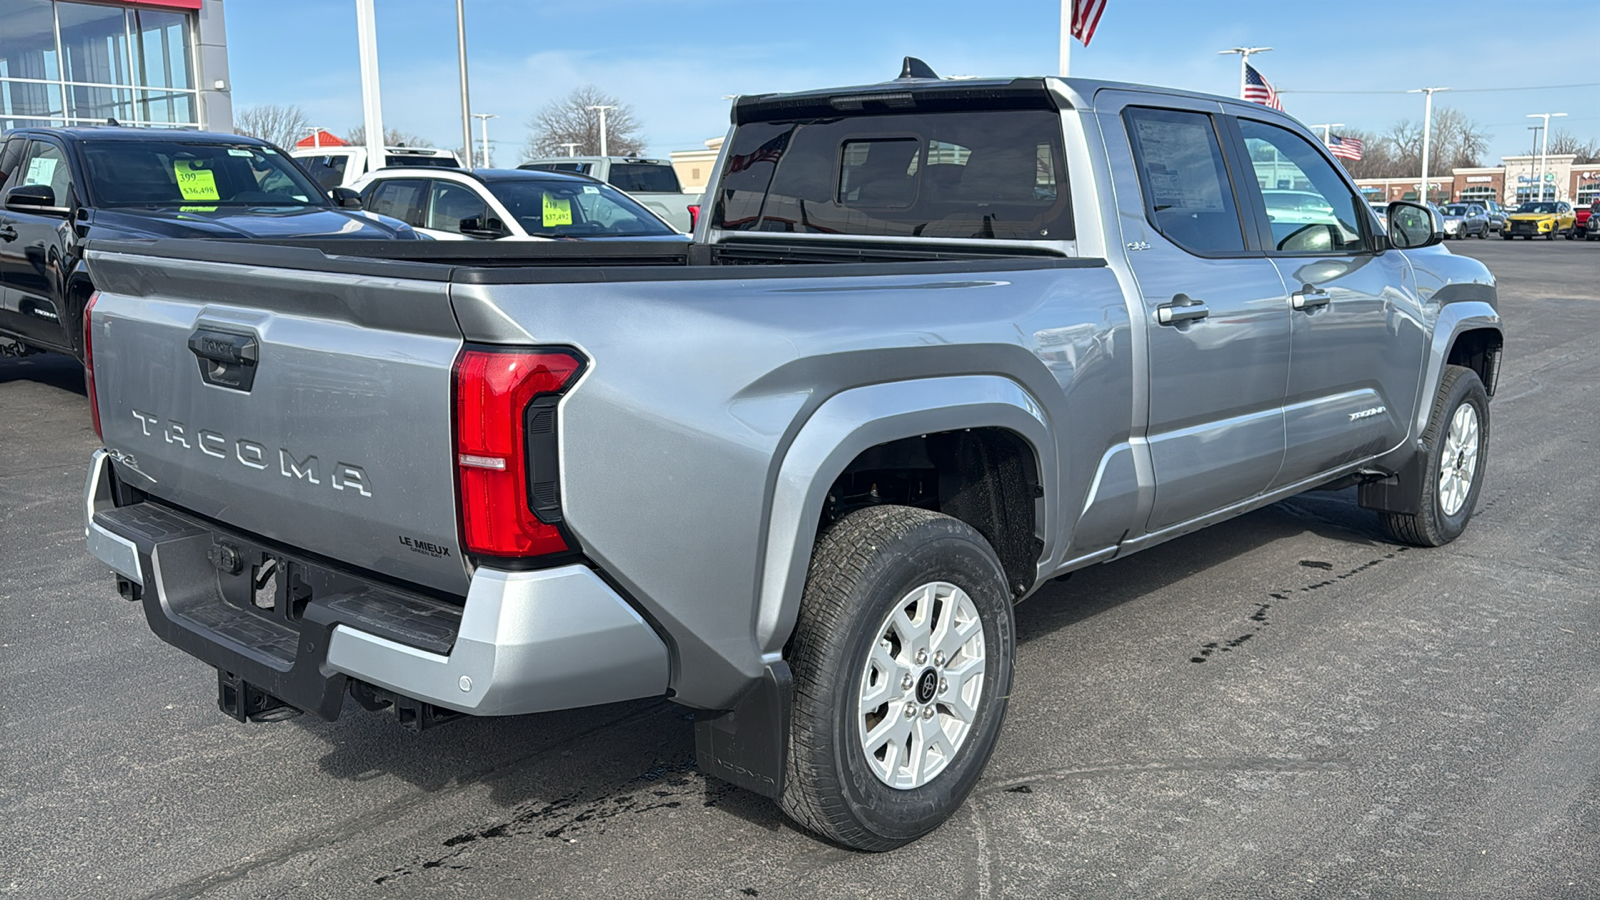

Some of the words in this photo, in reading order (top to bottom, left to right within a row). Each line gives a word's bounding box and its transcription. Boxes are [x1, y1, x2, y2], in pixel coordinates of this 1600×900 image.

[179, 173, 197, 182] 399
[204, 340, 234, 356] TOYOTA
[132, 408, 373, 497] TACOMA
[399, 535, 412, 547] LE
[414, 539, 451, 557] MIEUX
[410, 547, 430, 556] GREEN
